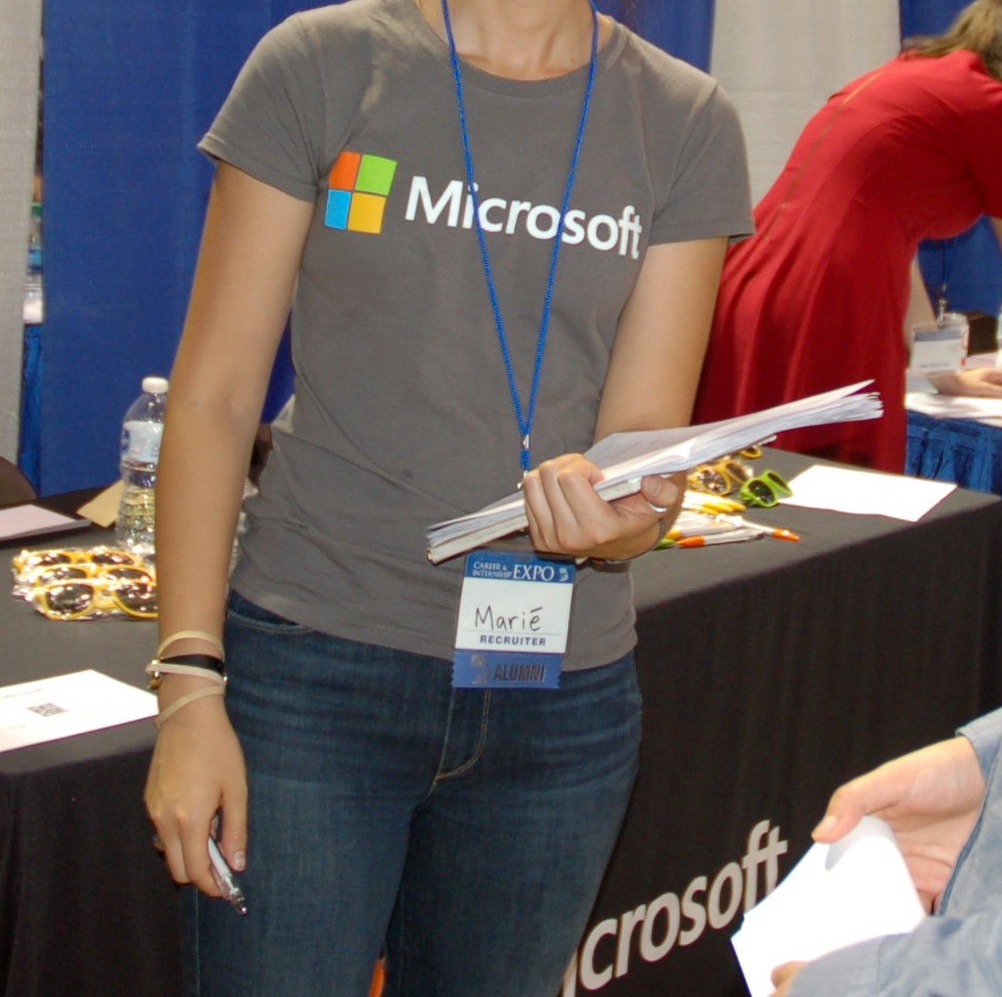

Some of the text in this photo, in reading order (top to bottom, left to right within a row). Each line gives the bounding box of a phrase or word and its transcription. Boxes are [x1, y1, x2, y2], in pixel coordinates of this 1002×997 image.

[405, 175, 642, 260] Microsoft
[513, 563, 555, 582] EXPO
[479, 634, 547, 646] RECRUITER
[493, 663, 547, 683] ALUMNI
